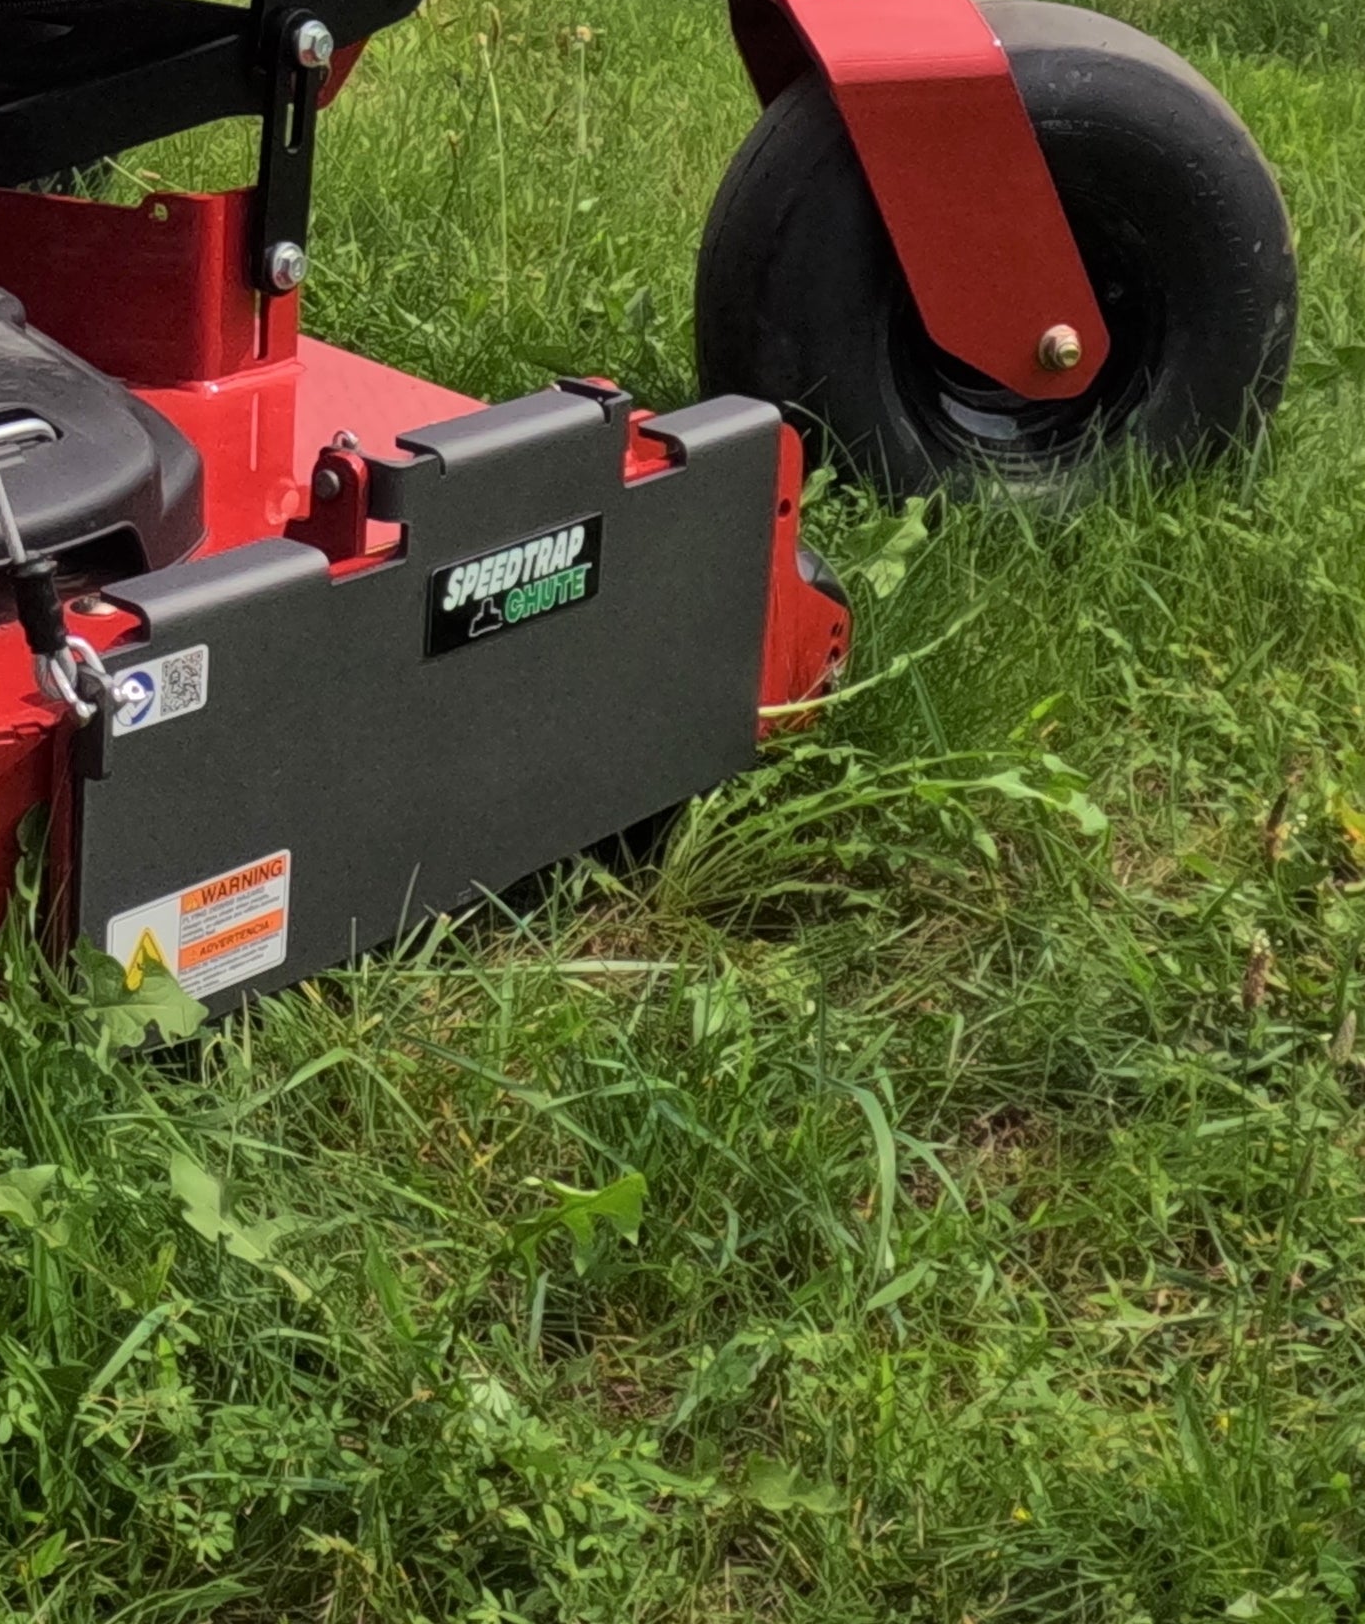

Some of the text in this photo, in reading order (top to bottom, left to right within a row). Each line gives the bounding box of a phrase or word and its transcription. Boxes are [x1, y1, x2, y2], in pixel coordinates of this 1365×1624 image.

[443, 525, 586, 612] SPEEDTRAP
[505, 565, 589, 623] CHUTE
[201, 859, 283, 906] WARNING
